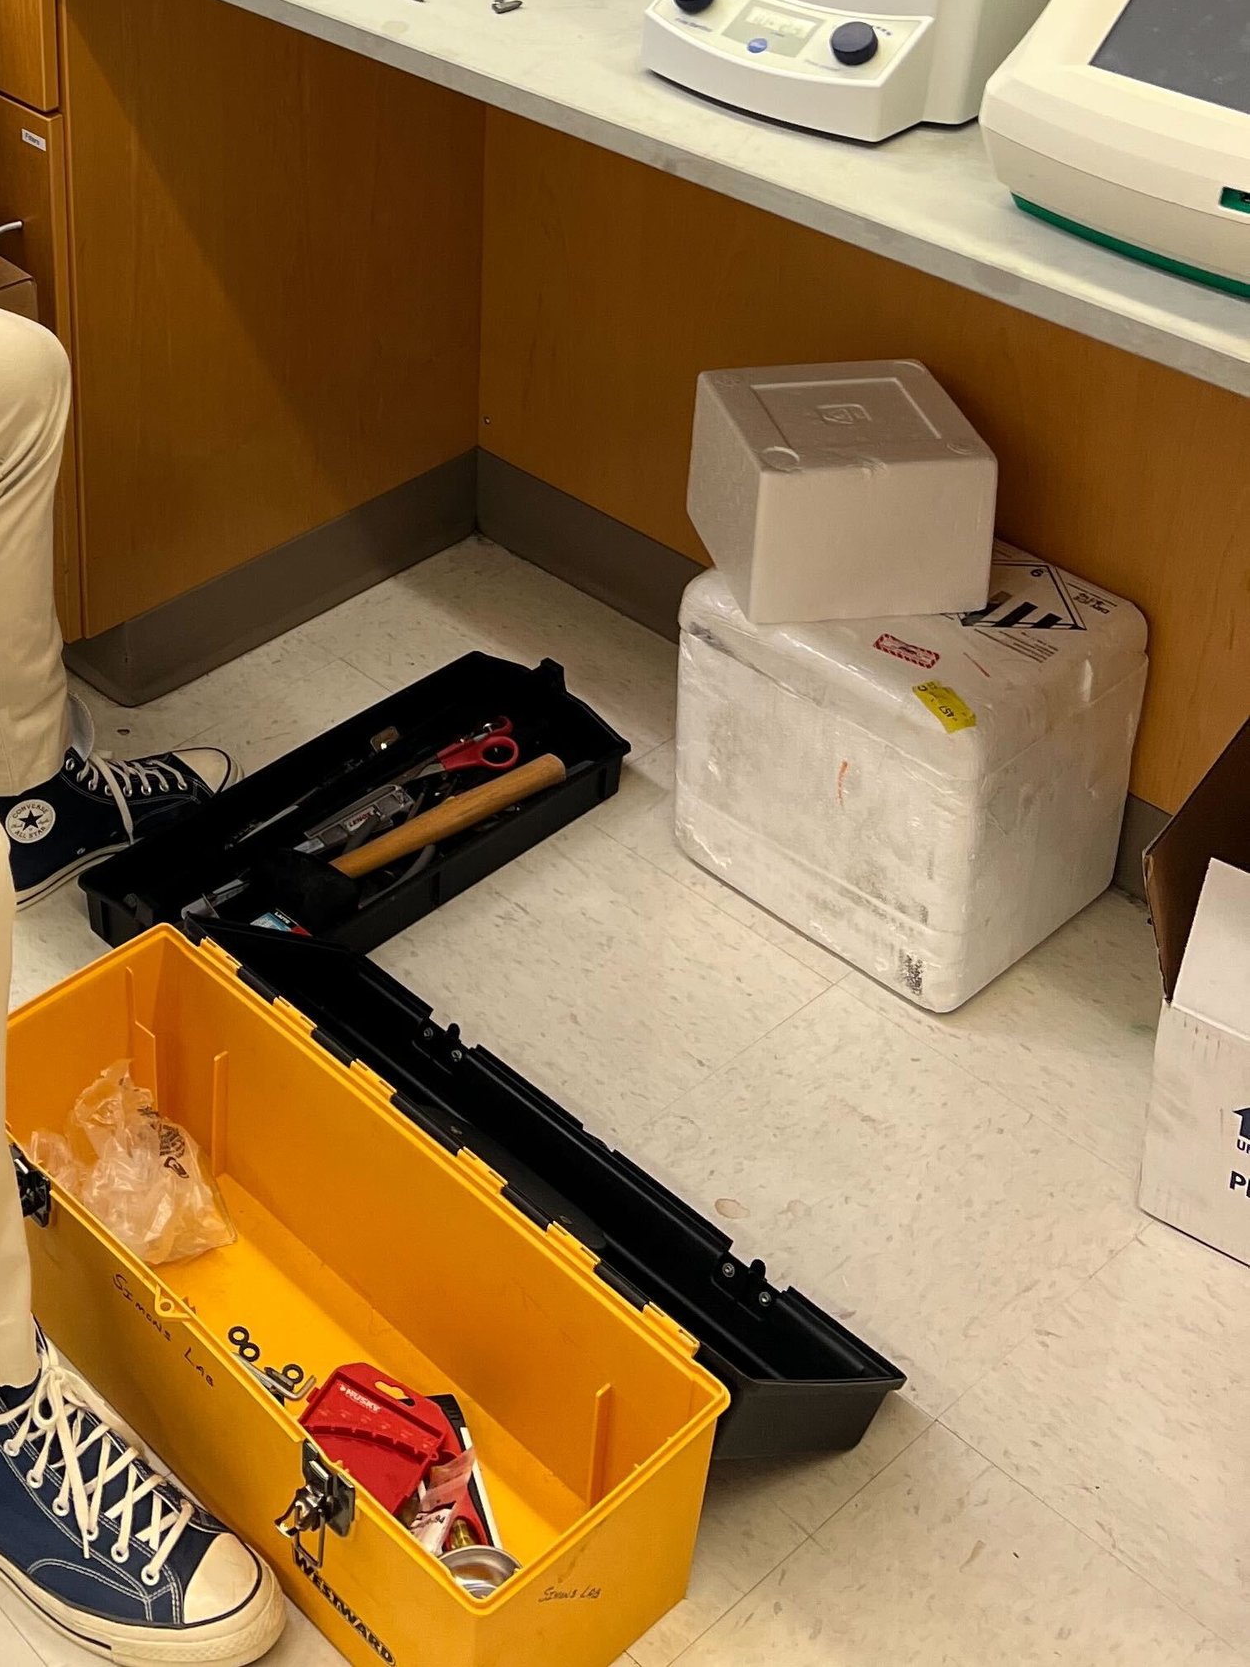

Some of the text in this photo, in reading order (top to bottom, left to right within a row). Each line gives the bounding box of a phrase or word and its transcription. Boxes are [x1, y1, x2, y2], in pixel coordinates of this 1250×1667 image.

[12, 803, 49, 819] CONVERSE
[29, 826, 46, 839] STAR
[345, 1387, 382, 1414] HUSKY
[293, 1546, 395, 1665] WESTWARD
